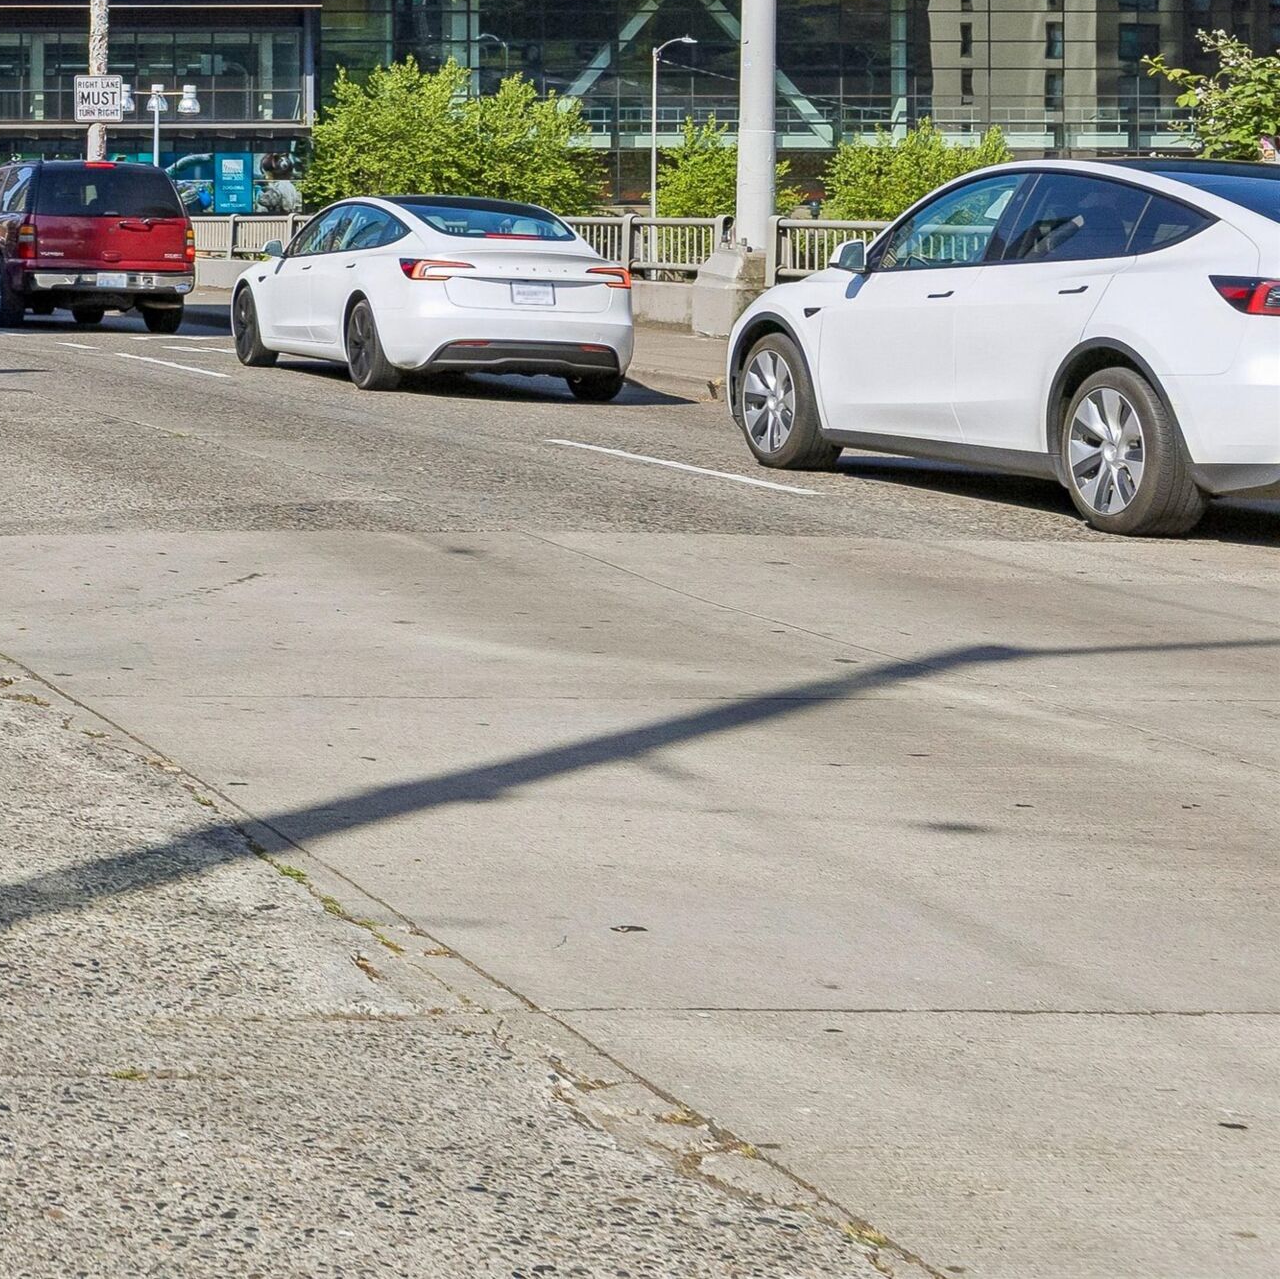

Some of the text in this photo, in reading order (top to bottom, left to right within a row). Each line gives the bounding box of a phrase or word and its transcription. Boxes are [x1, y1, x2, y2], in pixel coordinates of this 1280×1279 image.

[77, 81, 120, 89] RIGHT LANE
[81, 91, 118, 106] MUST
[78, 108, 120, 117] TURN RIGHT
